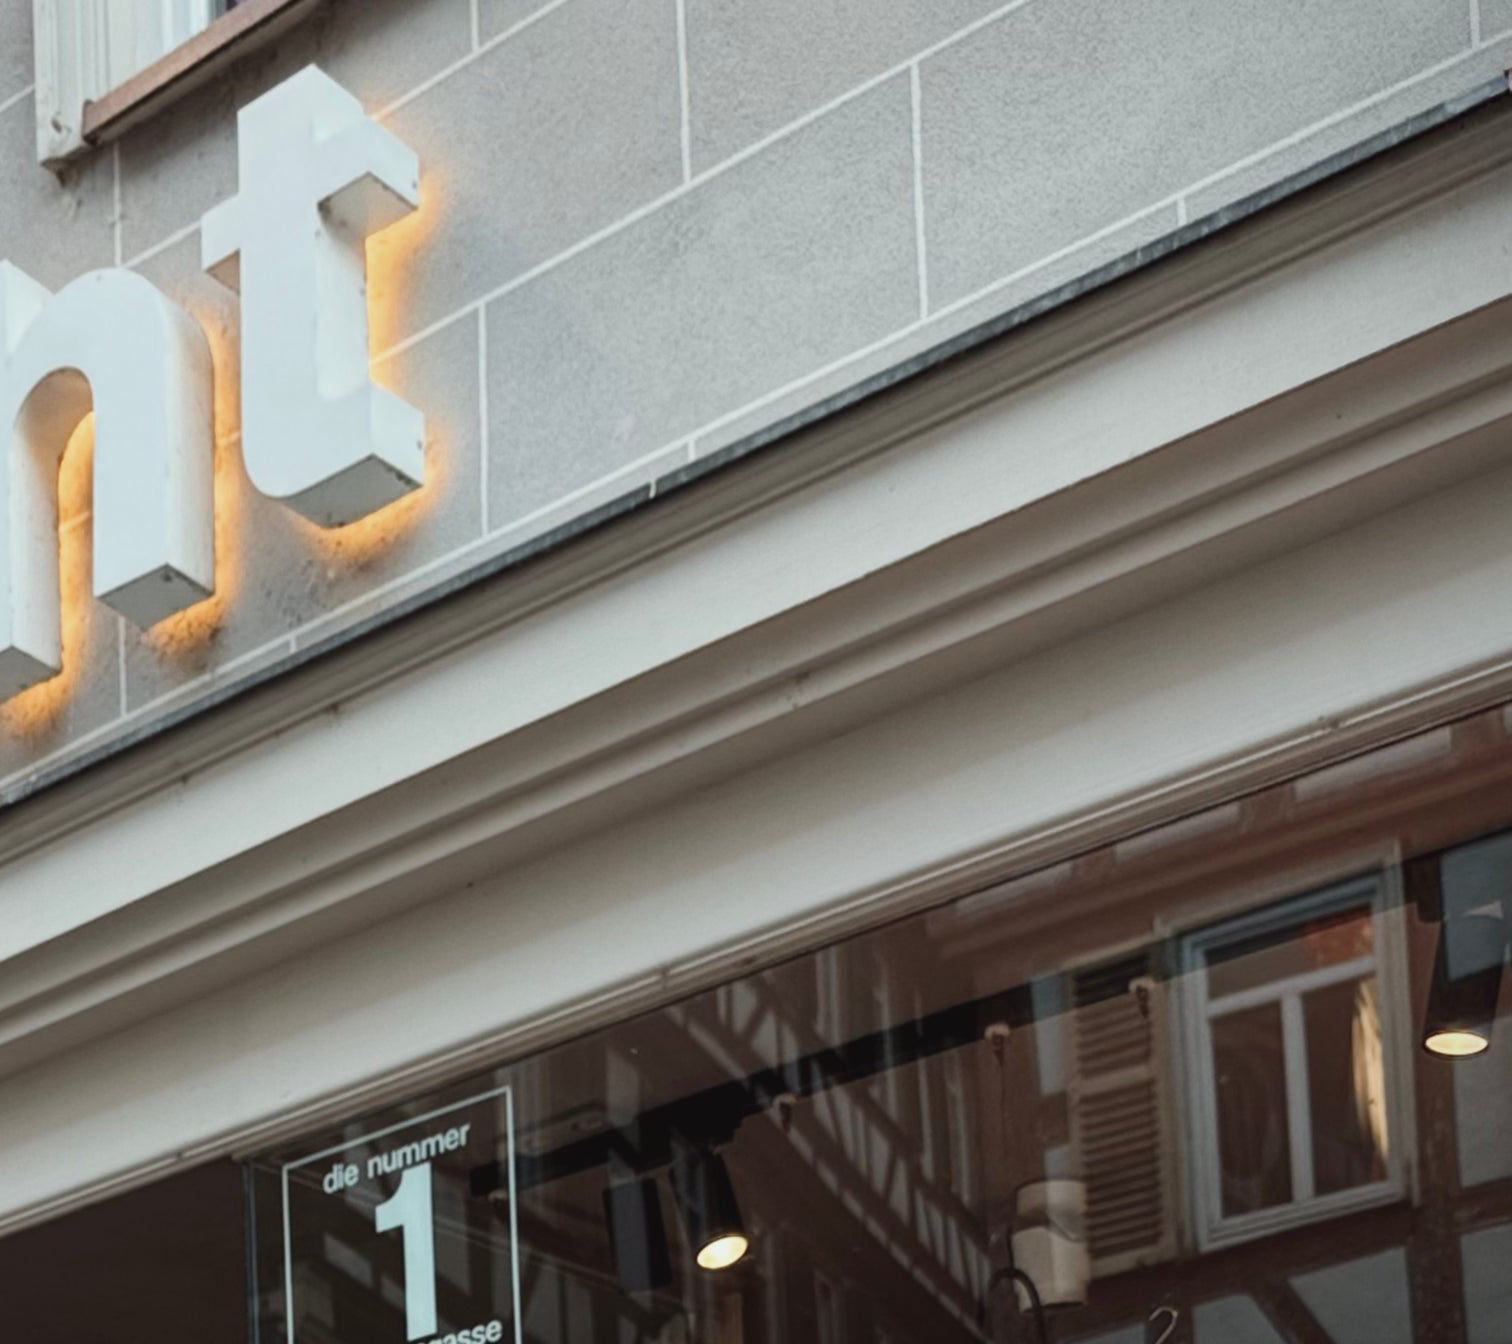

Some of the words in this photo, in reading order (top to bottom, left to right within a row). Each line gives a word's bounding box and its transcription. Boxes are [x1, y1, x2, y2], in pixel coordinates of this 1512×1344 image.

[323, 1163, 360, 1194] die
[367, 1123, 471, 1180] nummer
[375, 1161, 437, 1342] 1
